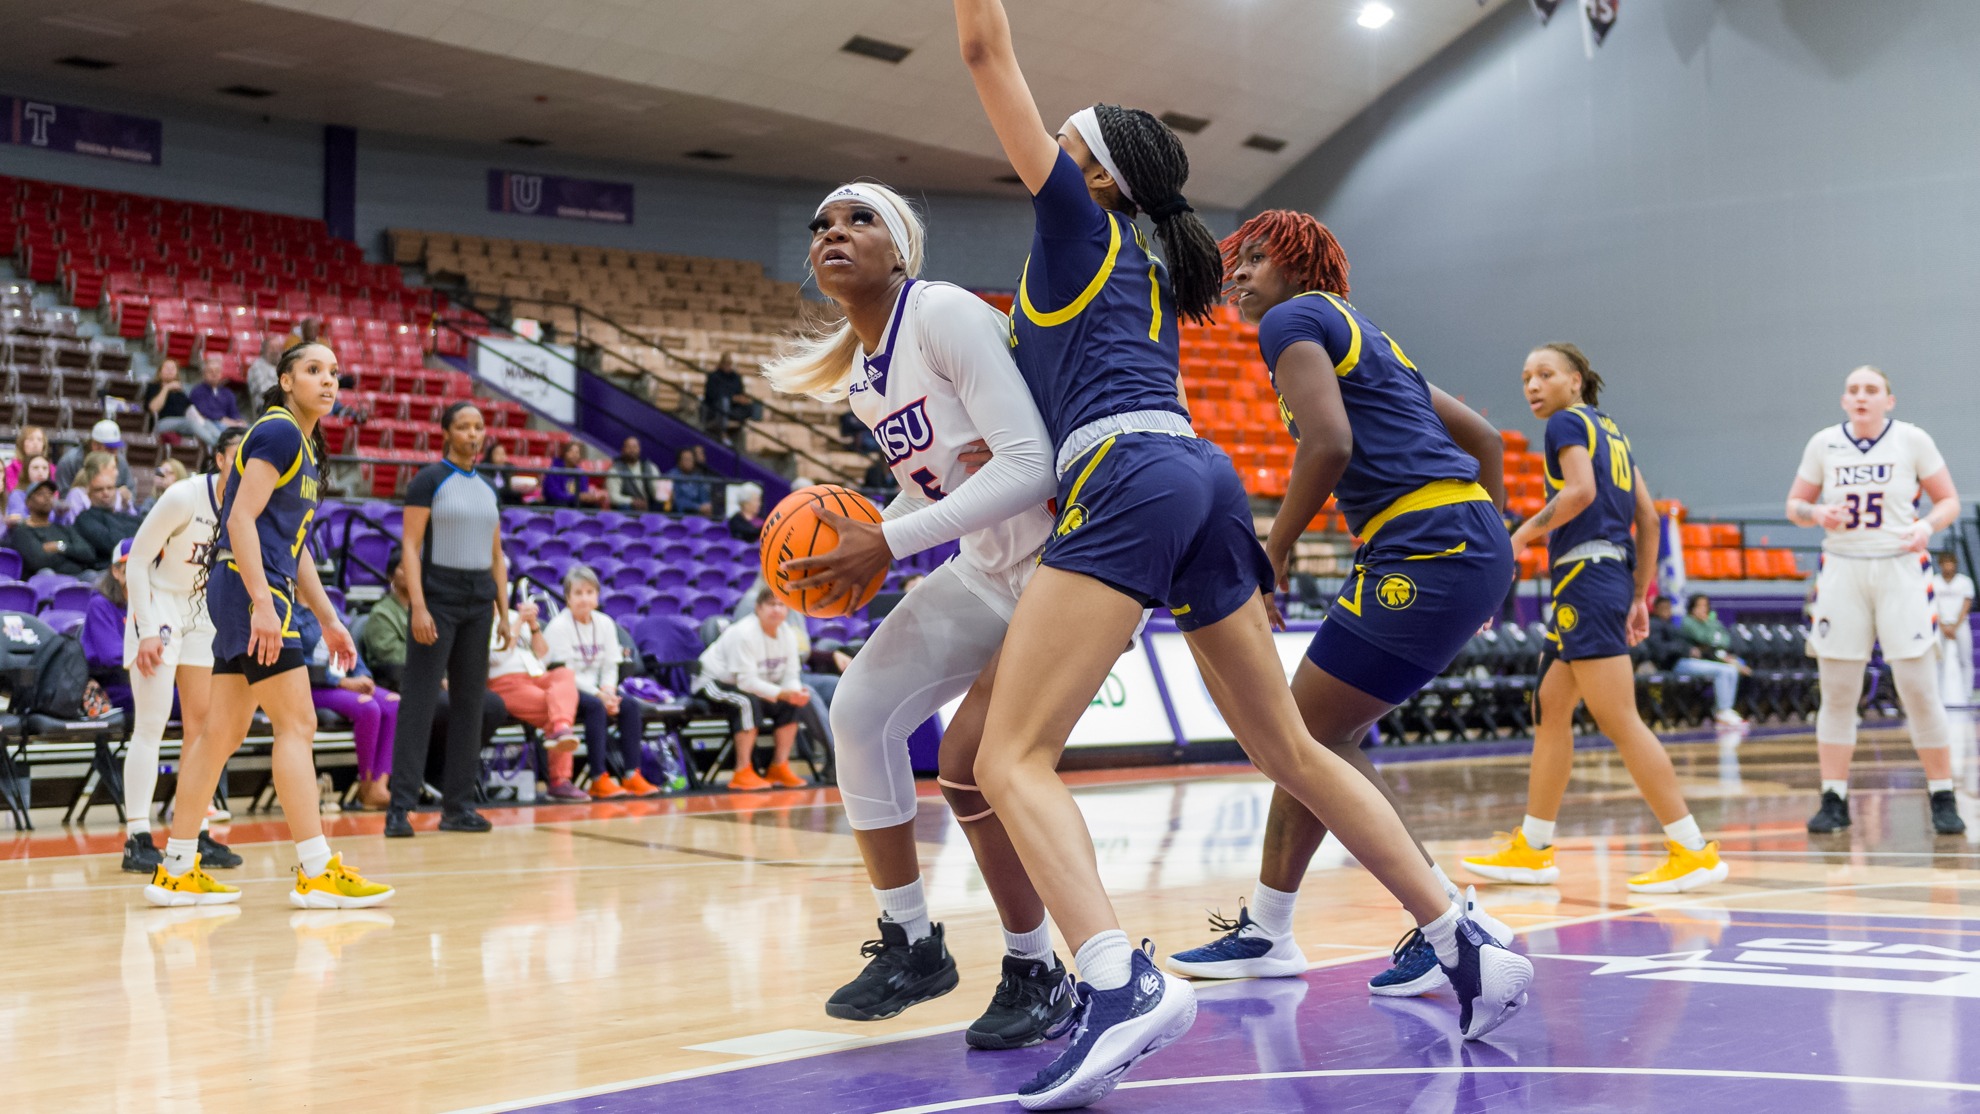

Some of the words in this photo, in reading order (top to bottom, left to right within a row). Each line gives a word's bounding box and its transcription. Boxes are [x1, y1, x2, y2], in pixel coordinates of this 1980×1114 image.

[25, 102, 56, 146] T
[511, 174, 542, 213] U
[874, 396, 934, 468] NSU
[1606, 433, 1632, 492] 10
[1834, 464, 1895, 487] NSU
[1845, 492, 1884, 529] 35
